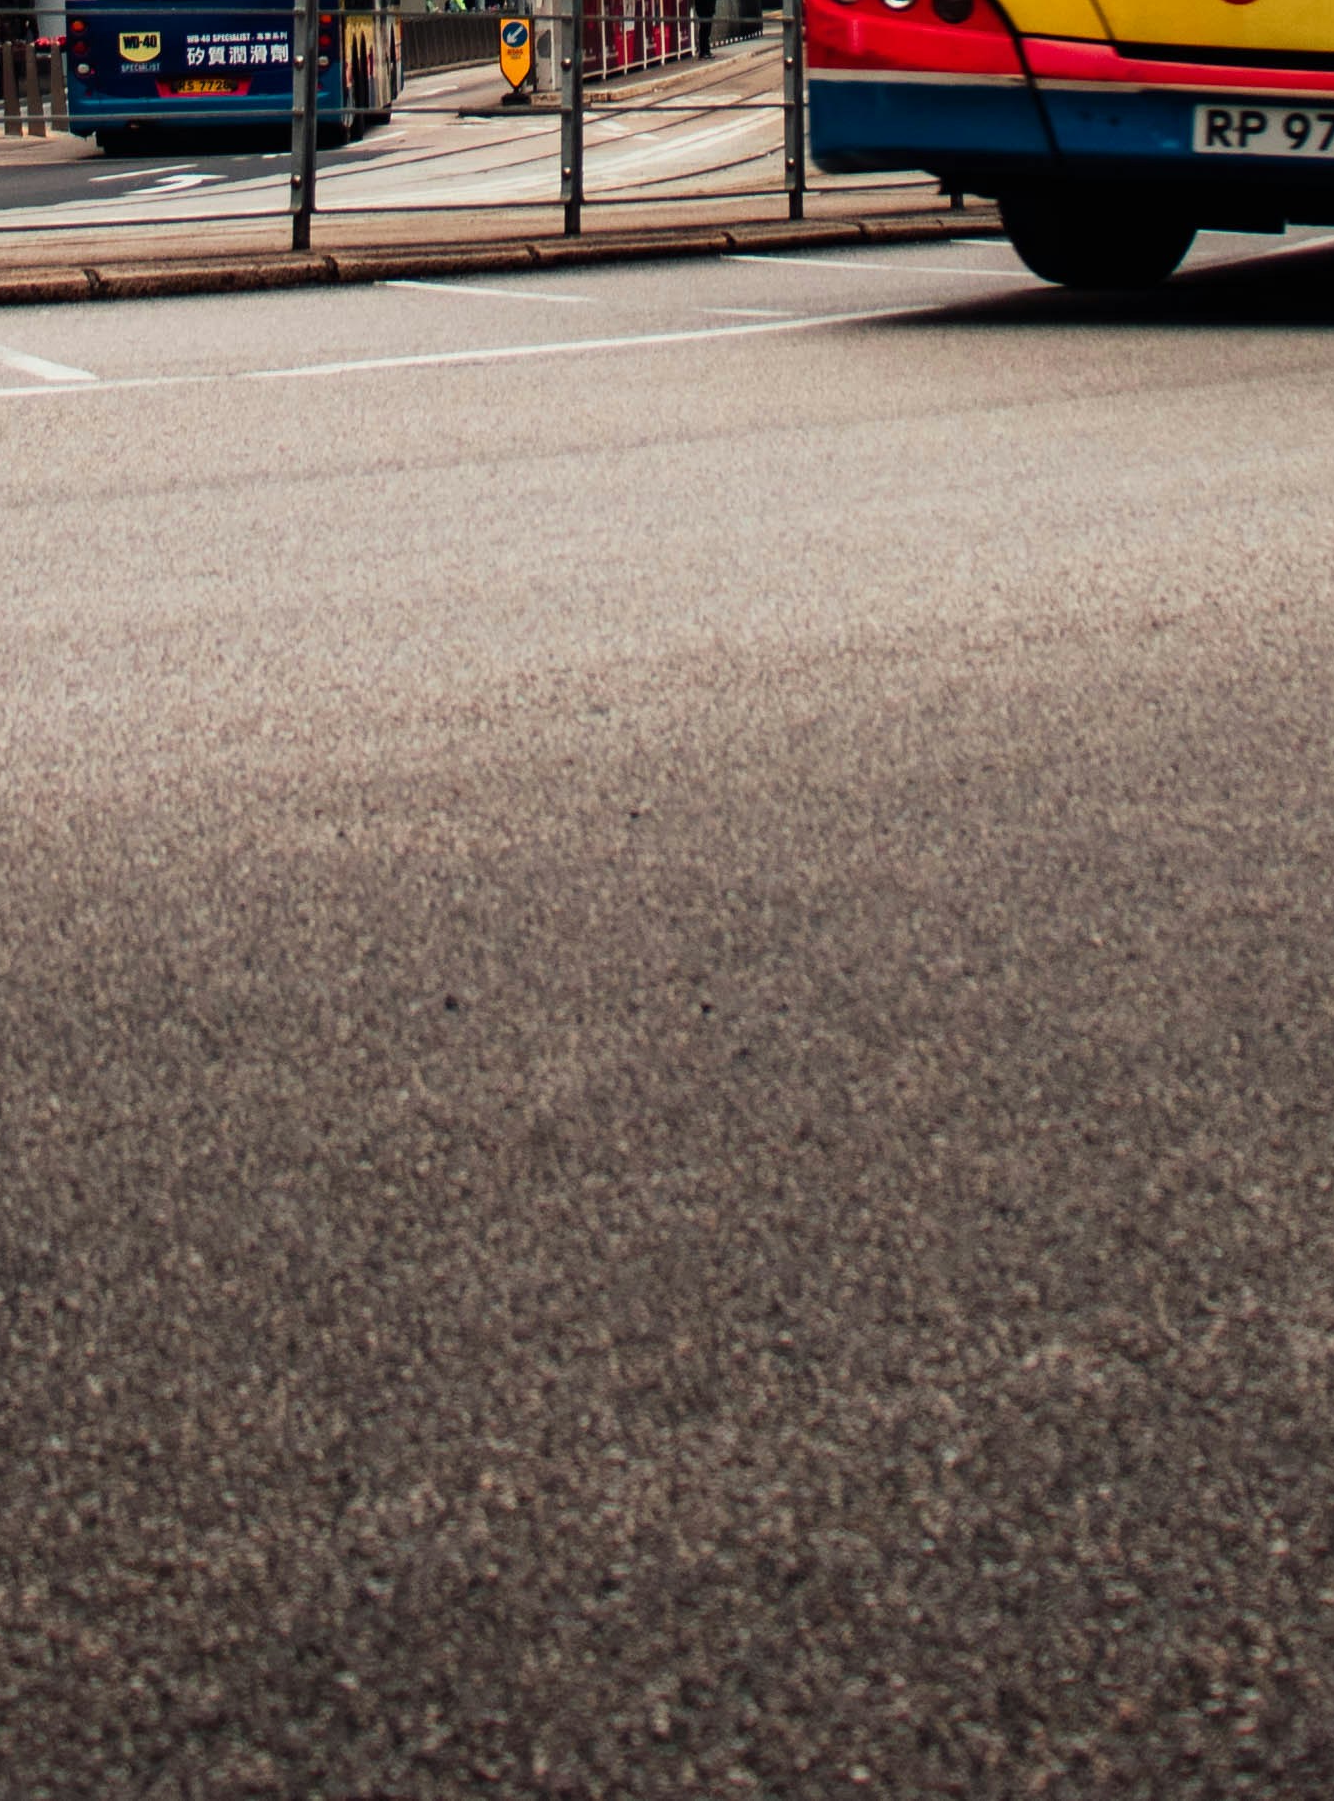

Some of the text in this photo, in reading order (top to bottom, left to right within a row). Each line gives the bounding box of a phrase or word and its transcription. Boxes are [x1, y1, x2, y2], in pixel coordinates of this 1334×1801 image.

[123, 35, 157, 49] WD-40
[186, 43, 289, 66] 矽質潤滑劑
[1204, 108, 1267, 148] RP
